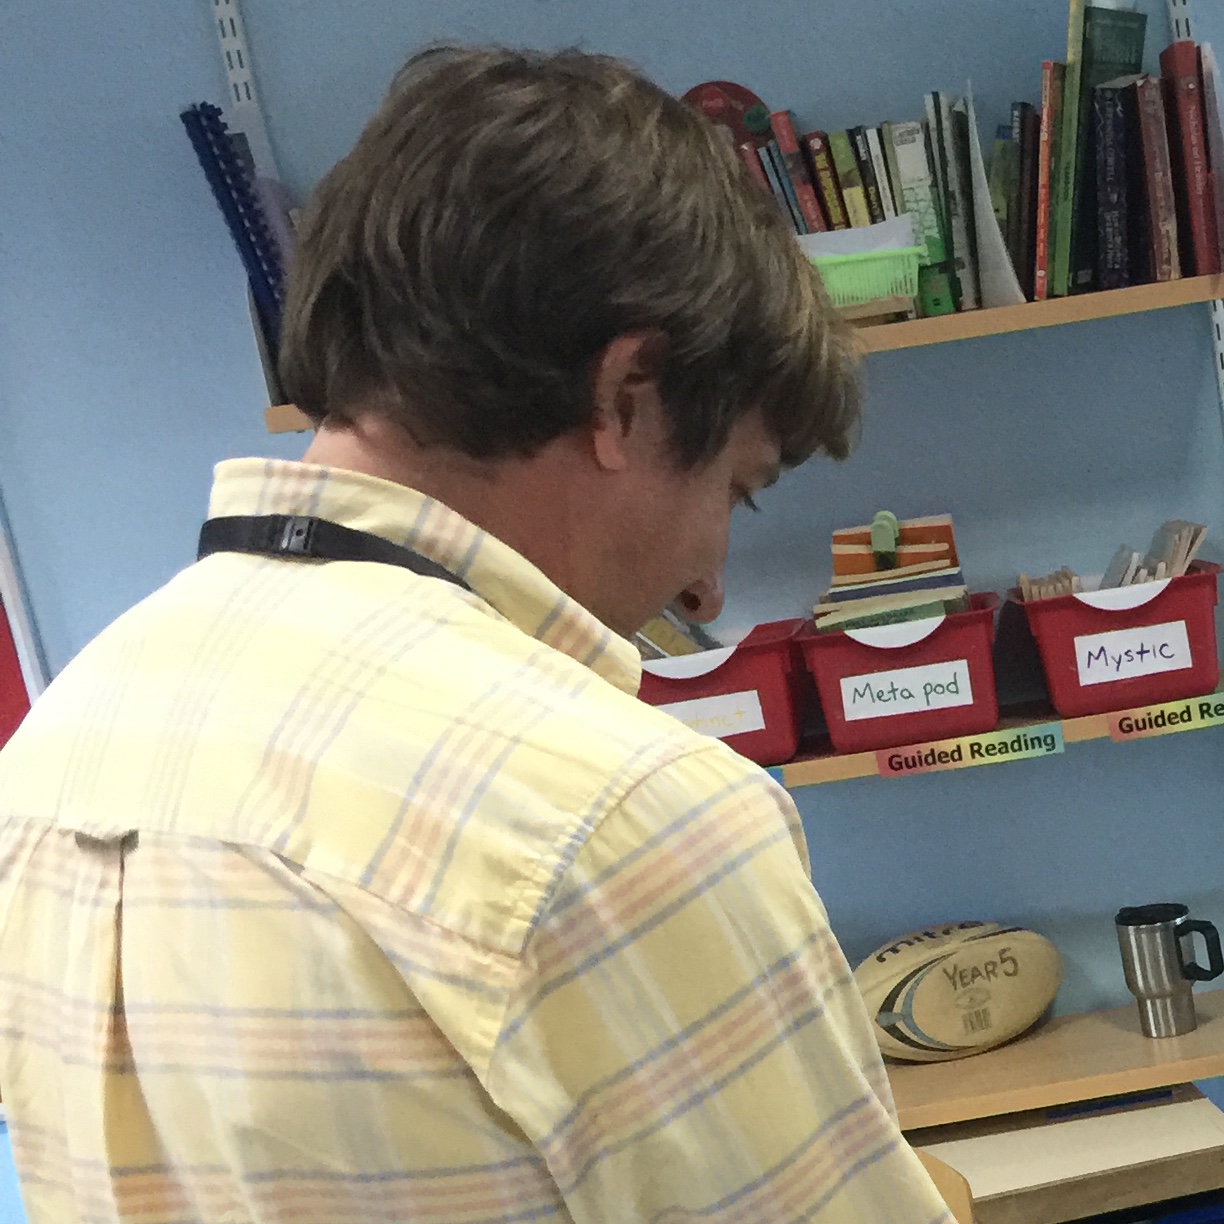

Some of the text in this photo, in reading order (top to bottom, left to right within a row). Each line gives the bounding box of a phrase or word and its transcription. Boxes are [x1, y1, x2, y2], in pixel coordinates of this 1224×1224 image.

[1087, 642, 1175, 672] Mystic
[852, 672, 960, 706] Meta pod
[1118, 705, 1192, 735] Guided
[887, 733, 1056, 773] Guided Reading
[942, 947, 1018, 990] YEAR 5
